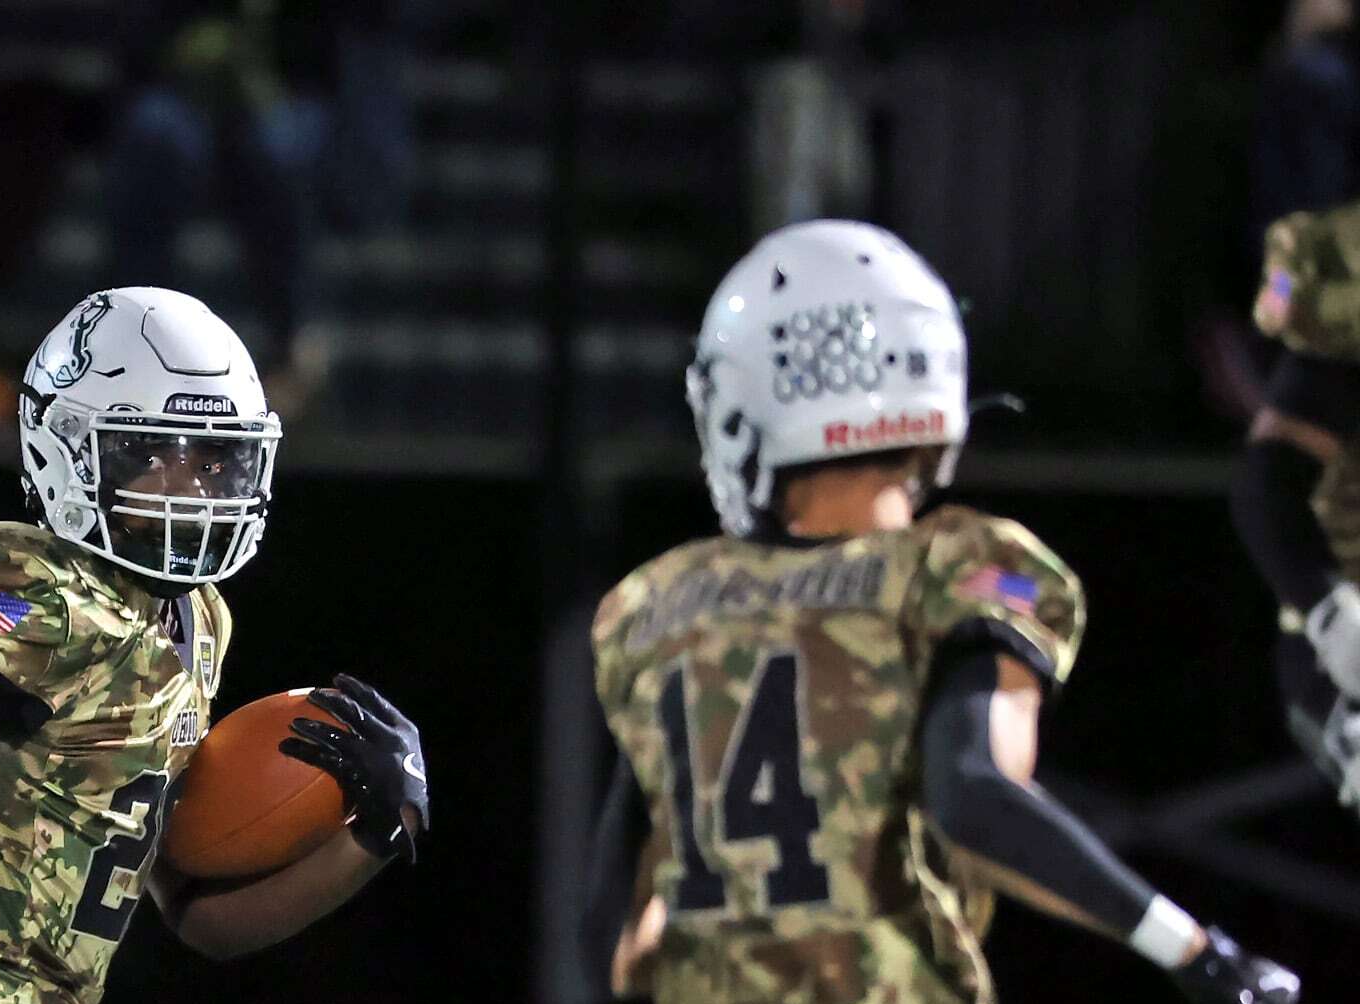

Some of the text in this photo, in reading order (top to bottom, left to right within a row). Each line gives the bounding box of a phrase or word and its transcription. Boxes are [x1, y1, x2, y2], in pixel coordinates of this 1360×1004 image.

[175, 398, 232, 413] Riddell
[68, 767, 171, 946] 2
[654, 650, 833, 914] 14
